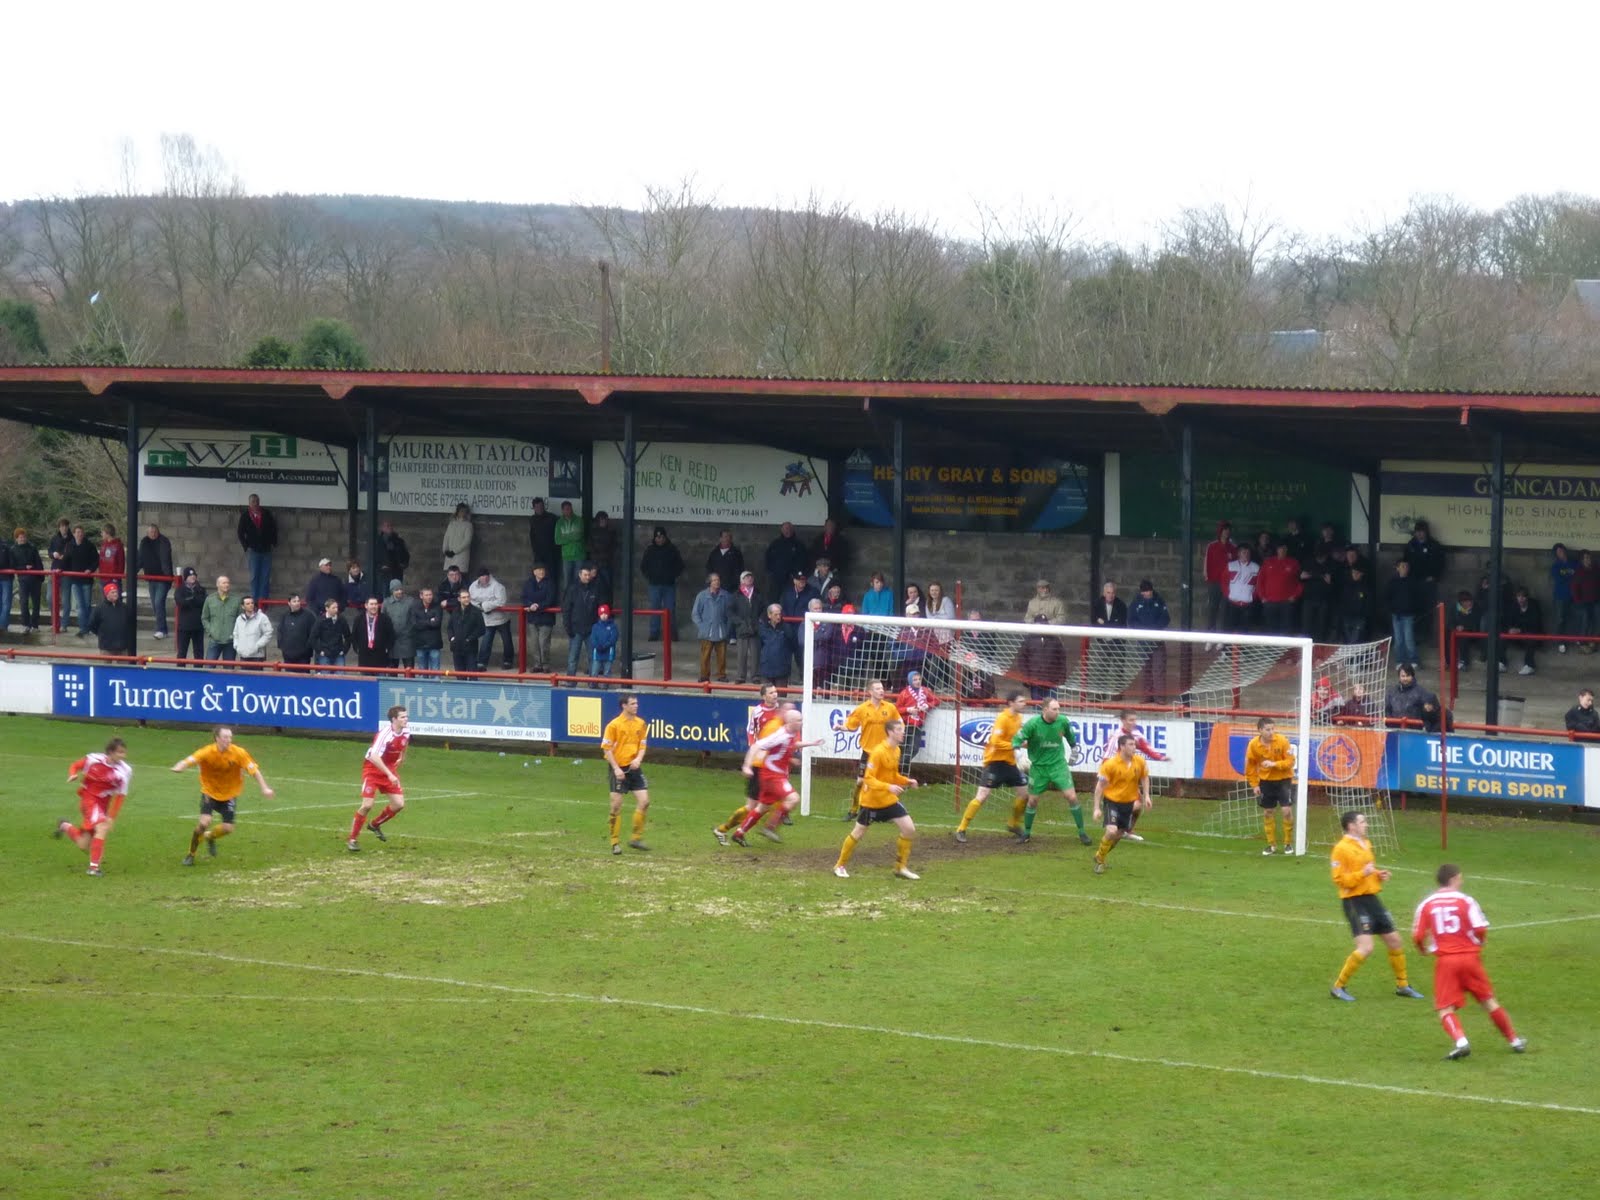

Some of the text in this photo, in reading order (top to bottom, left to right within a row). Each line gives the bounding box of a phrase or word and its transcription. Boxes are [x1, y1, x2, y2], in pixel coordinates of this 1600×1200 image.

[391, 442, 547, 462] MURRAY TAYLOR
[227, 470, 337, 482] Chartered Accountants
[389, 462, 549, 478] CHARTERED CERTIFIED ACCOUNTANTS
[660, 454, 718, 482] KEN REID
[938, 466, 985, 482] GRAY
[991, 468, 1003, 483] &
[1010, 468, 1057, 484] SONS
[421, 478, 517, 491] REGISTERED AUDITORS
[669, 477, 676, 491] &
[683, 478, 755, 504] CONTRACTOR
[1474, 477, 1600, 497] GENCADAM
[390, 492, 438, 506] MONTROSE
[472, 494, 518, 509] ARBROATH
[690, 507, 714, 516] MOB:
[1447, 503, 1525, 517] HIGHLND
[1531, 506, 1586, 519] SINGLE
[109, 679, 362, 719] Turner & Townsend
[389, 687, 482, 720] Tristar
[570, 721, 600, 735] savills
[1427, 740, 1555, 771] THE COURIER
[1467, 778, 1502, 794] FOR
[1507, 782, 1567, 799] SPORT
[1431, 906, 1460, 934] 15
